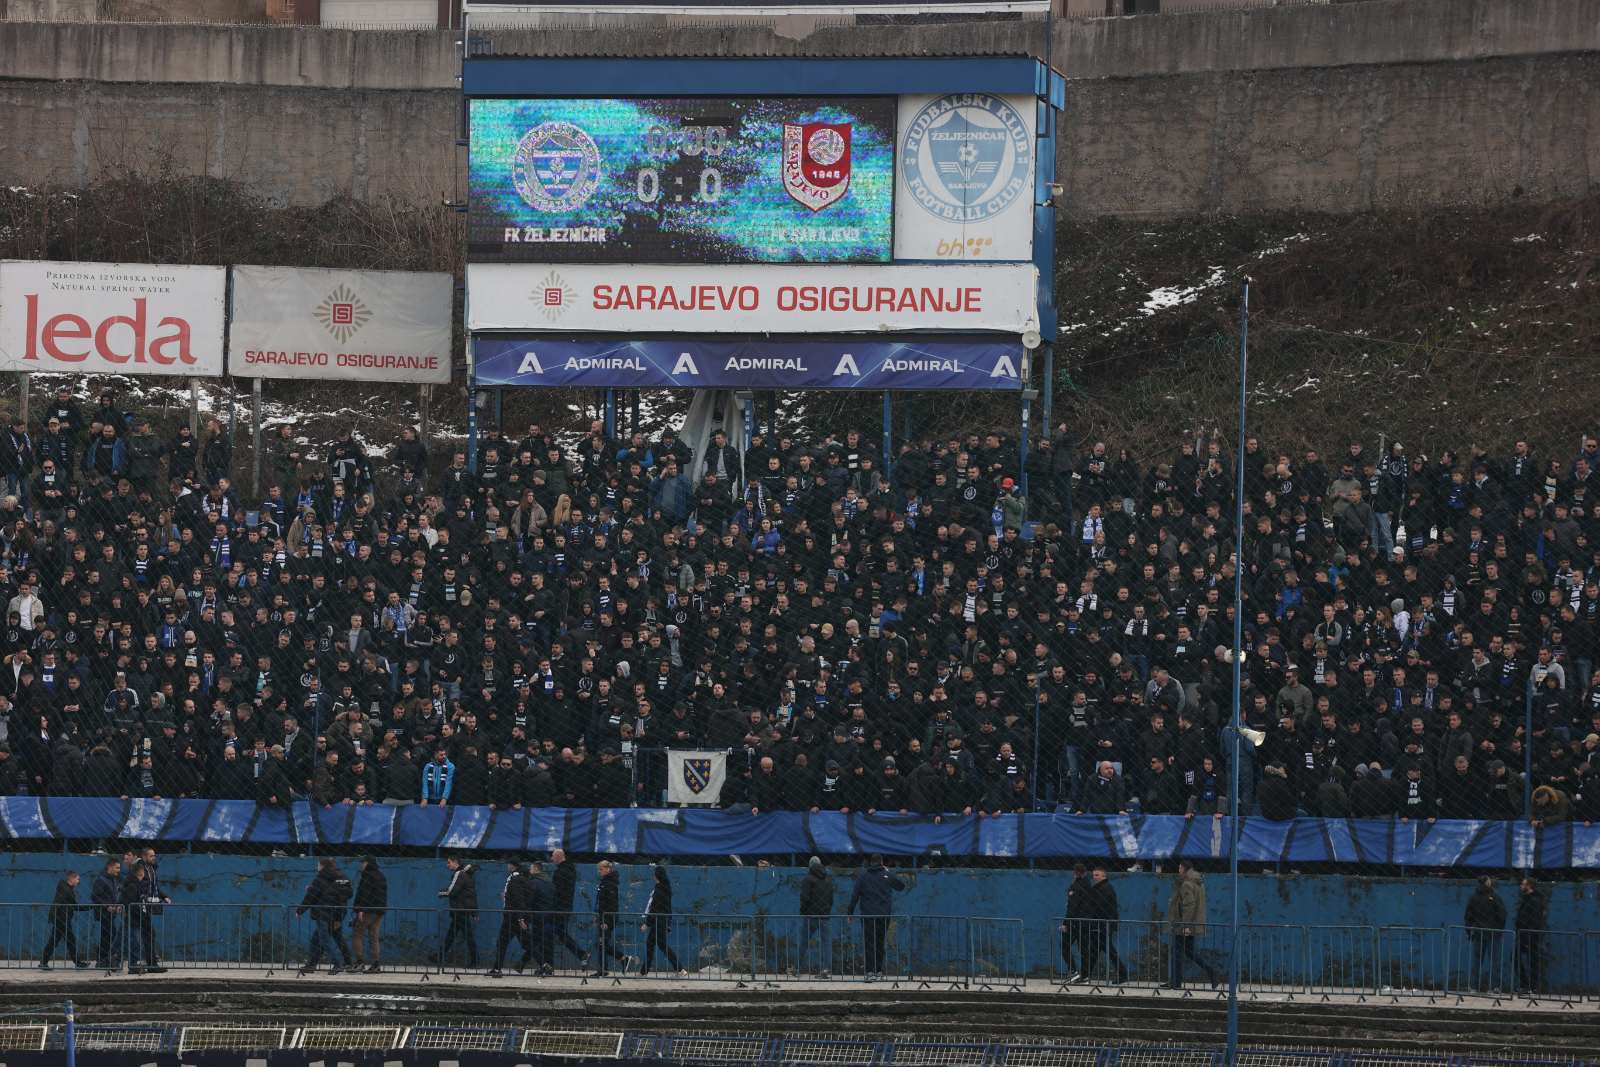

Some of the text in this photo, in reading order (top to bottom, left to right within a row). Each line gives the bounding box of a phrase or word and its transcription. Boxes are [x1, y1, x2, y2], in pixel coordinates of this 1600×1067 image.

[906, 94, 1029, 154] FUDBALSKI KLUB
[910, 177, 1024, 220] FOOTBALL CLUB
[504, 227, 520, 242] FK
[46, 271, 95, 281] PRIRODNA
[52, 282, 171, 294] NATURAL SPRING WATER
[593, 285, 982, 313] SARAJEVO OSIGURANJE
[22, 294, 198, 365] leda
[245, 350, 439, 370] SARAJEVO OSIGURANJE
[564, 356, 647, 371] ADMIRAL
[725, 357, 808, 372] ADMIRAL
[881, 358, 965, 373] ADMIRAL
